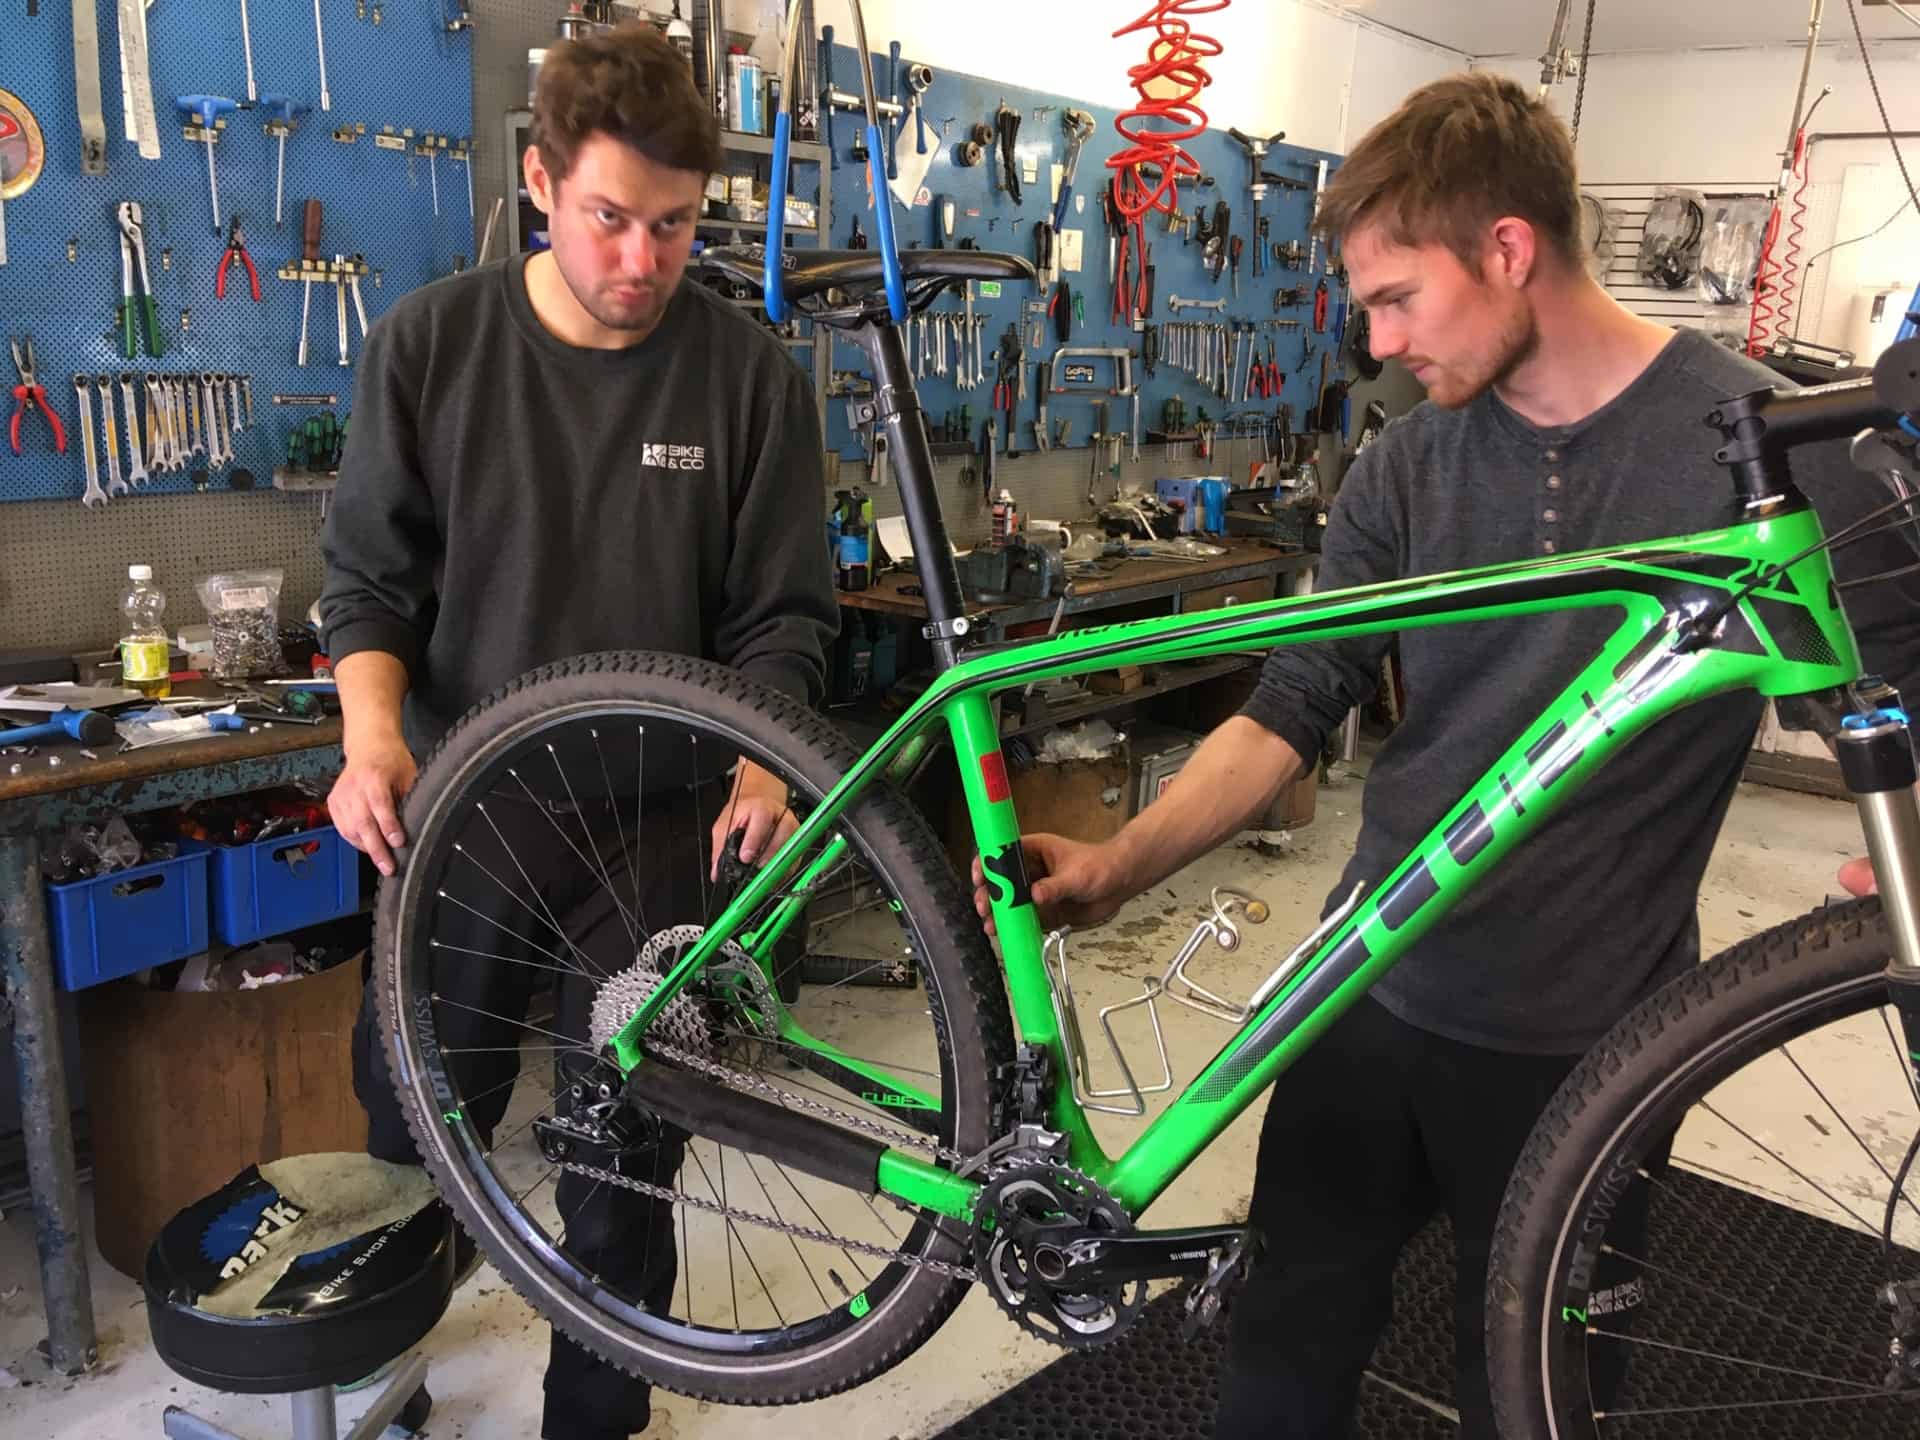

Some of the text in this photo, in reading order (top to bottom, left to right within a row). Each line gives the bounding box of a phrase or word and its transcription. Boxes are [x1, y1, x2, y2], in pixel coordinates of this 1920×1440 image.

[668, 444, 705, 458] BIKE
[415, 996, 439, 1059] SWISS
[1583, 1152, 1639, 1240] SWISS
[319, 1268, 354, 1298] BIKE
[352, 1234, 389, 1267] SHOP
